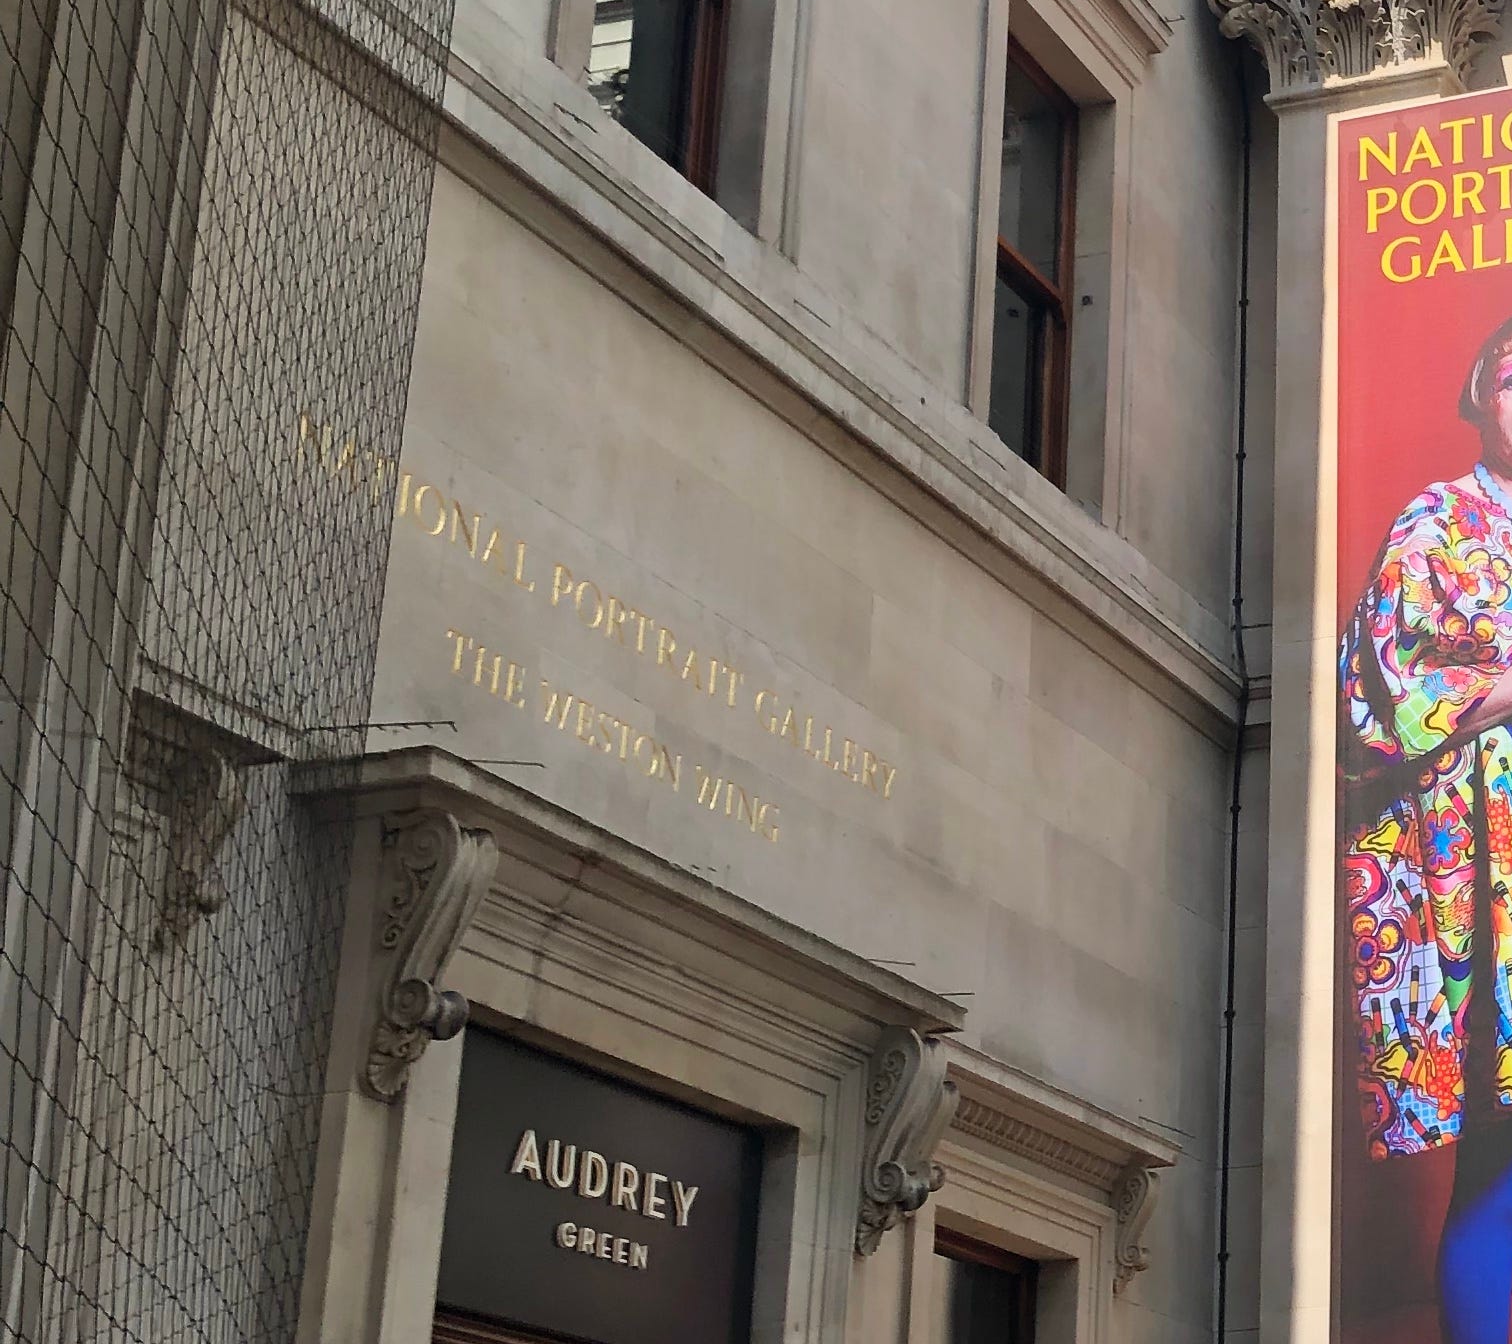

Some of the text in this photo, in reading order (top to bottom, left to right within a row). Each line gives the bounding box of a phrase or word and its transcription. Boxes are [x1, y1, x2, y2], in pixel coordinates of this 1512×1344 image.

[446, 627, 780, 843] THE WESTON WING
[551, 563, 744, 707] PORTRAIT
[755, 688, 897, 799] GALLERY
[510, 1129, 699, 1227] AUDREY
[556, 1222, 649, 1269] GREEN
